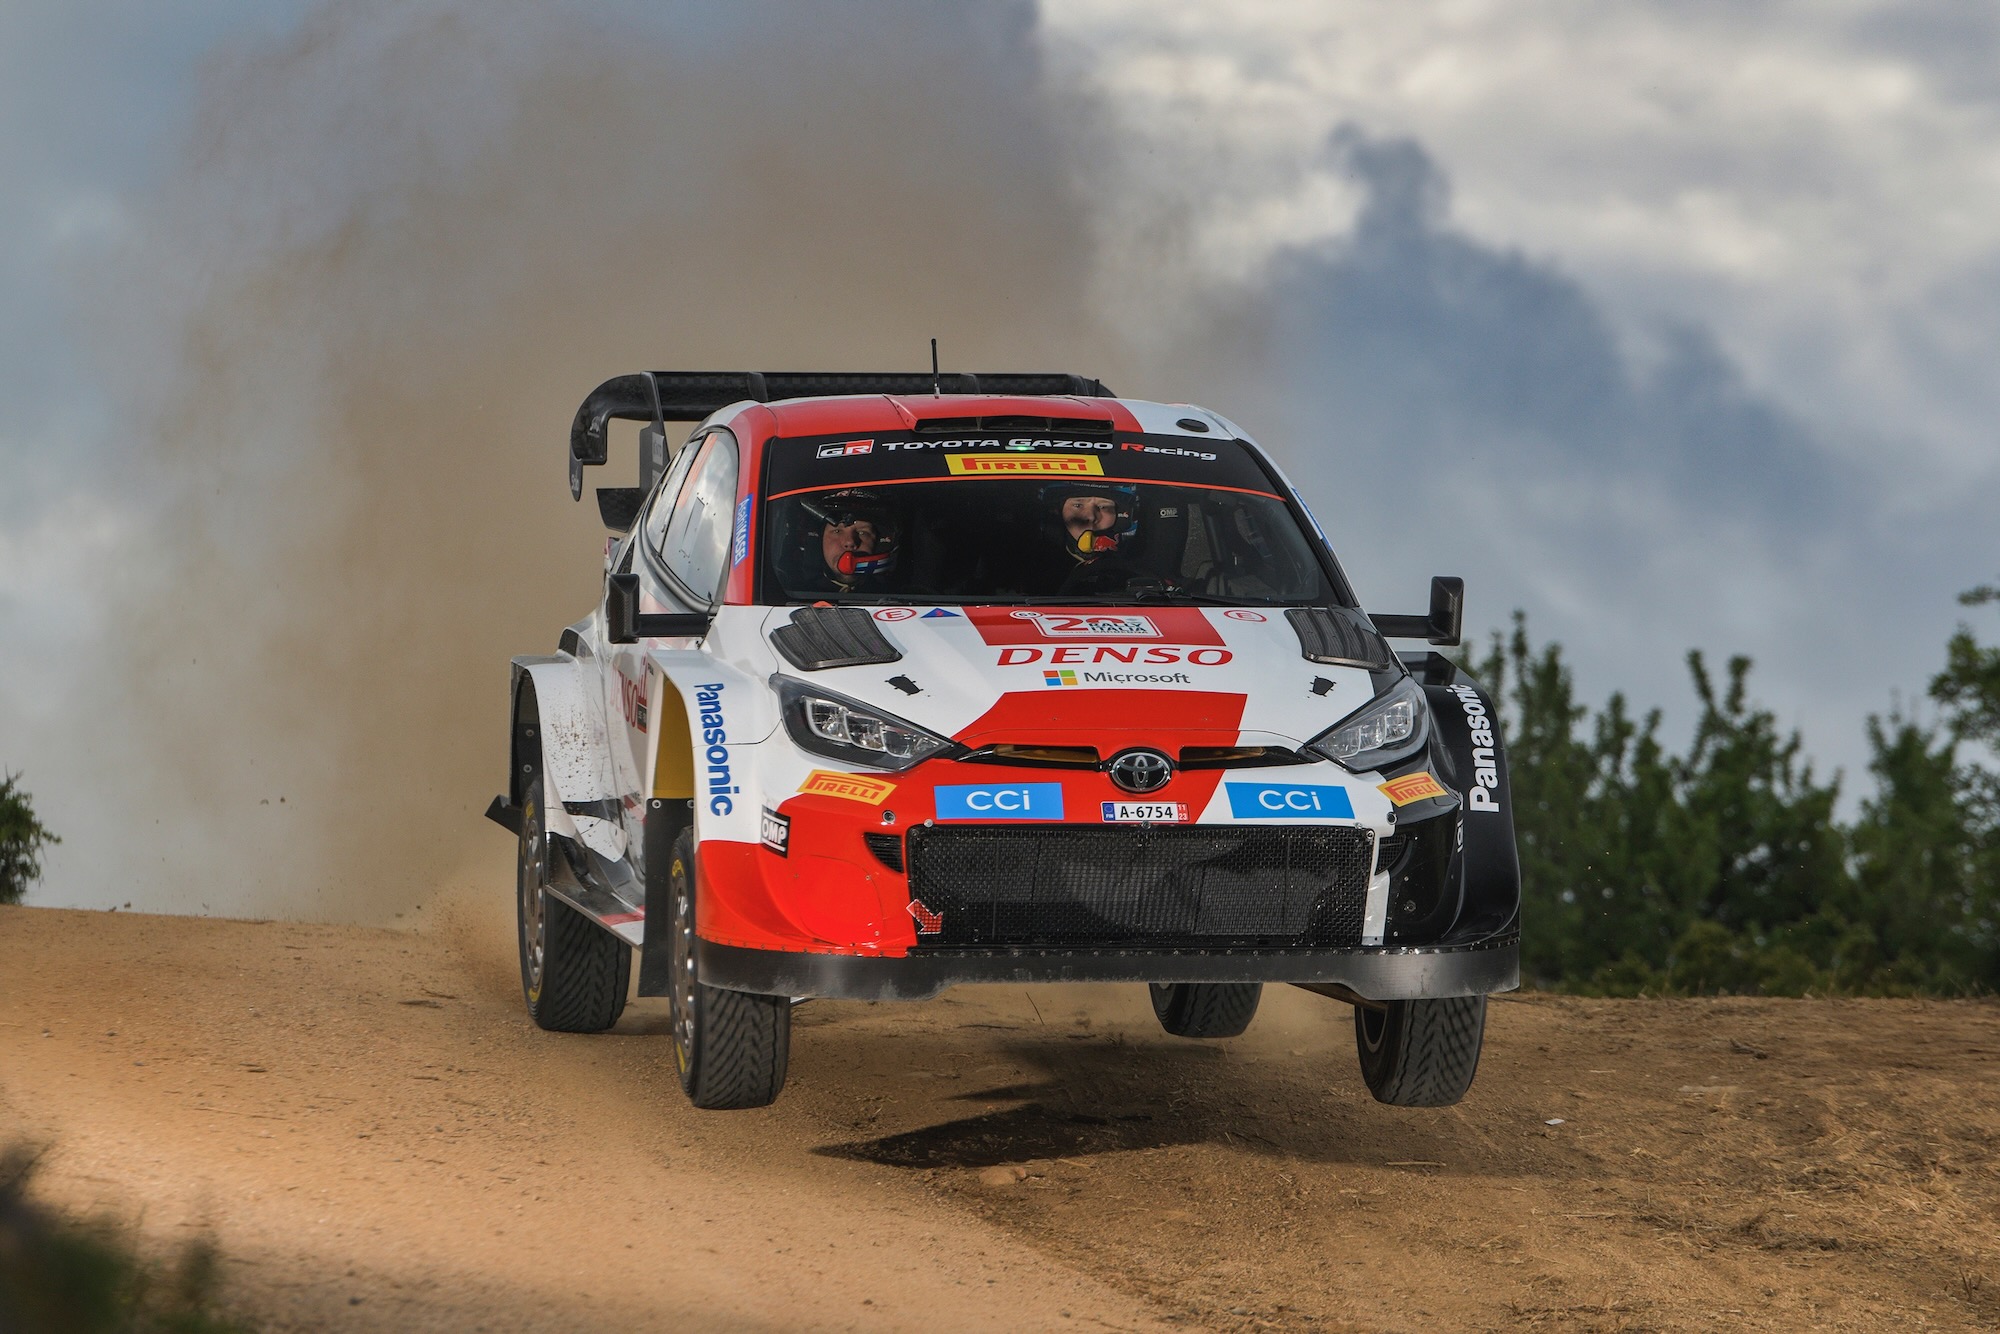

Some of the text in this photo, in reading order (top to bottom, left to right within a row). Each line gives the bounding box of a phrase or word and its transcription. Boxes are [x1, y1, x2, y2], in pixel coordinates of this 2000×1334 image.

[819, 445, 872, 457] GR
[882, 438, 1217, 461] TOYOTA GAZOO Racing
[961, 457, 1088, 471] PIRELLI
[1160, 508, 1178, 517] OMP
[996, 647, 1234, 666] DENSO
[1083, 671, 1191, 684] Microsoft
[693, 683, 740, 817] Panasonic
[1445, 684, 1500, 813] Panasonic
[804, 773, 887, 800] PIRELLI
[1384, 776, 1441, 802] PIRELLI
[966, 789, 1031, 811] CCi
[1258, 789, 1322, 811] CCi
[1119, 805, 1173, 819] A-6754
[761, 818, 788, 845] OMP
